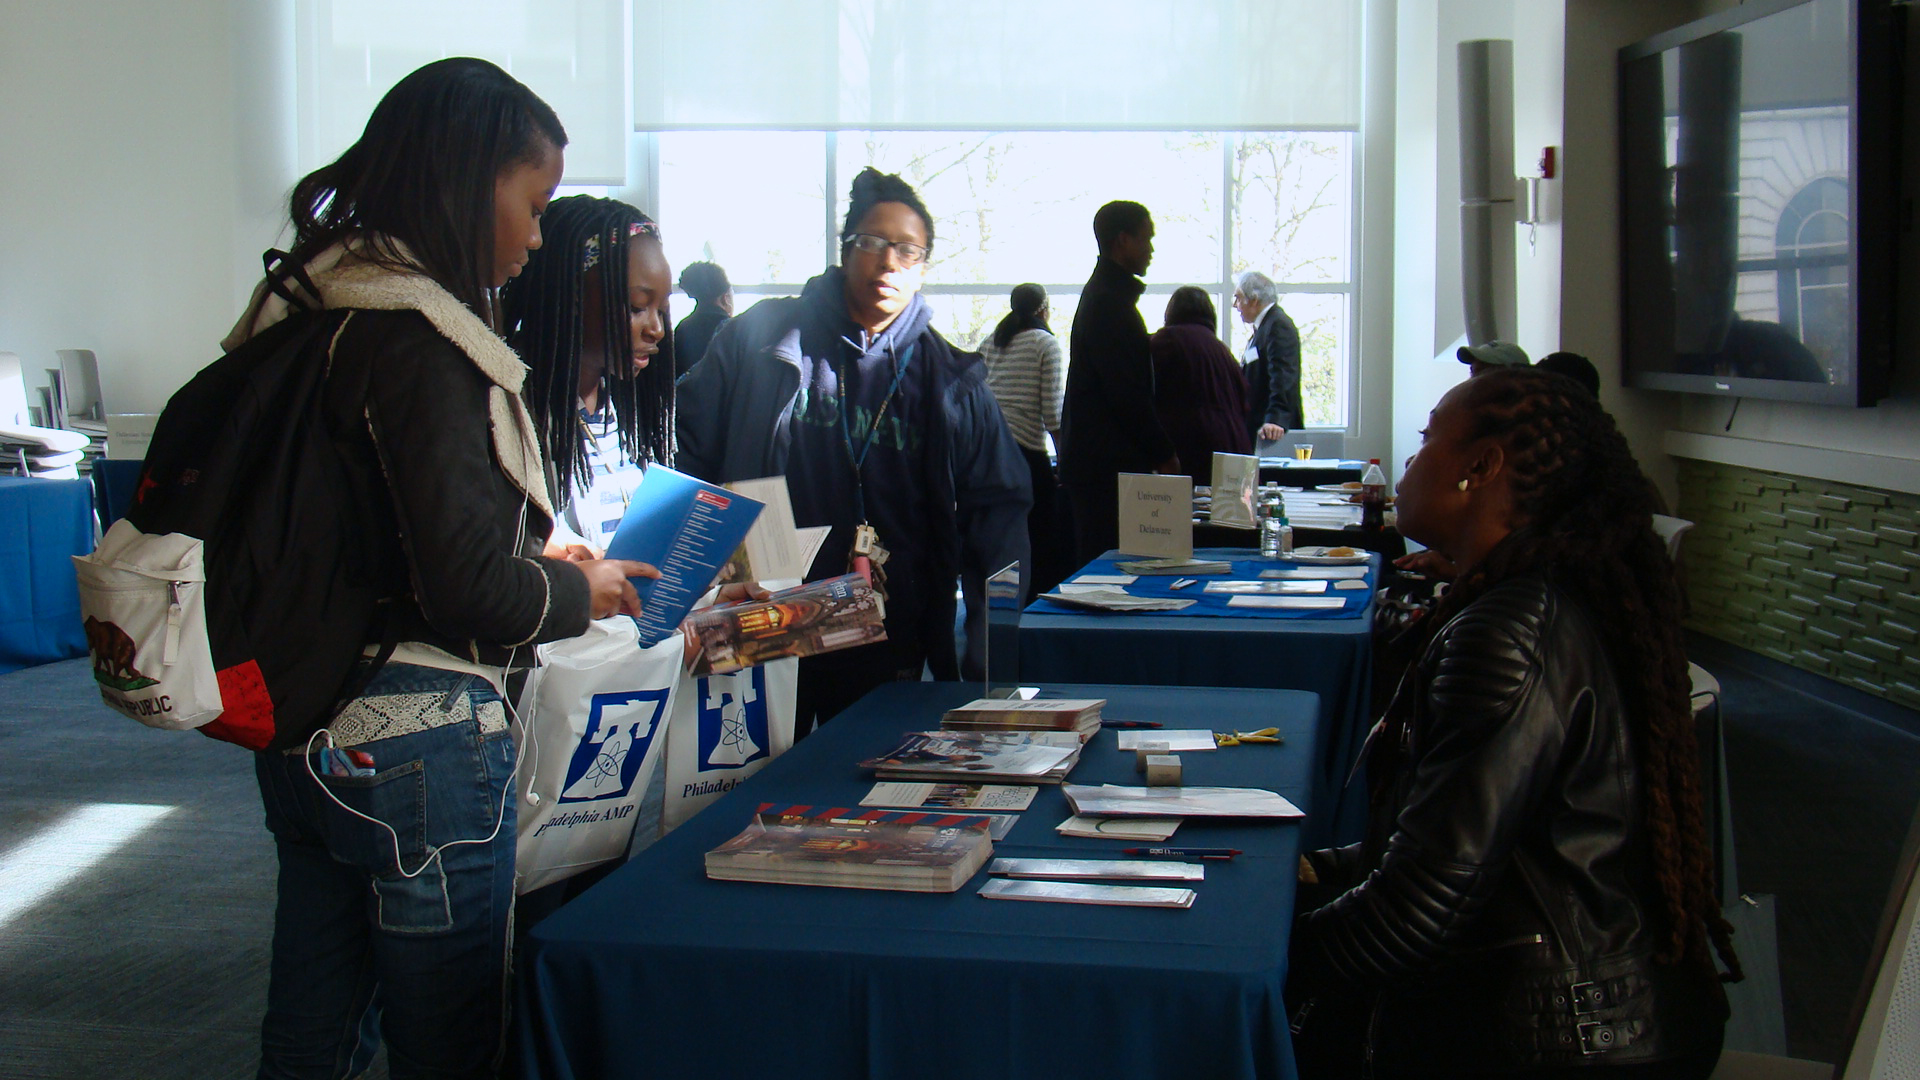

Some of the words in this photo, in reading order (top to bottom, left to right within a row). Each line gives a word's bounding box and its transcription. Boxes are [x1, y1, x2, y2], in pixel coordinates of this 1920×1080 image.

[1137, 491, 1172, 503] University
[1151, 509, 1159, 518] of
[1140, 524, 1172, 535] Delaware
[682, 776, 747, 798] Philadel
[533, 809, 600, 837] Padelphia
[600, 804, 634, 822] AMP
